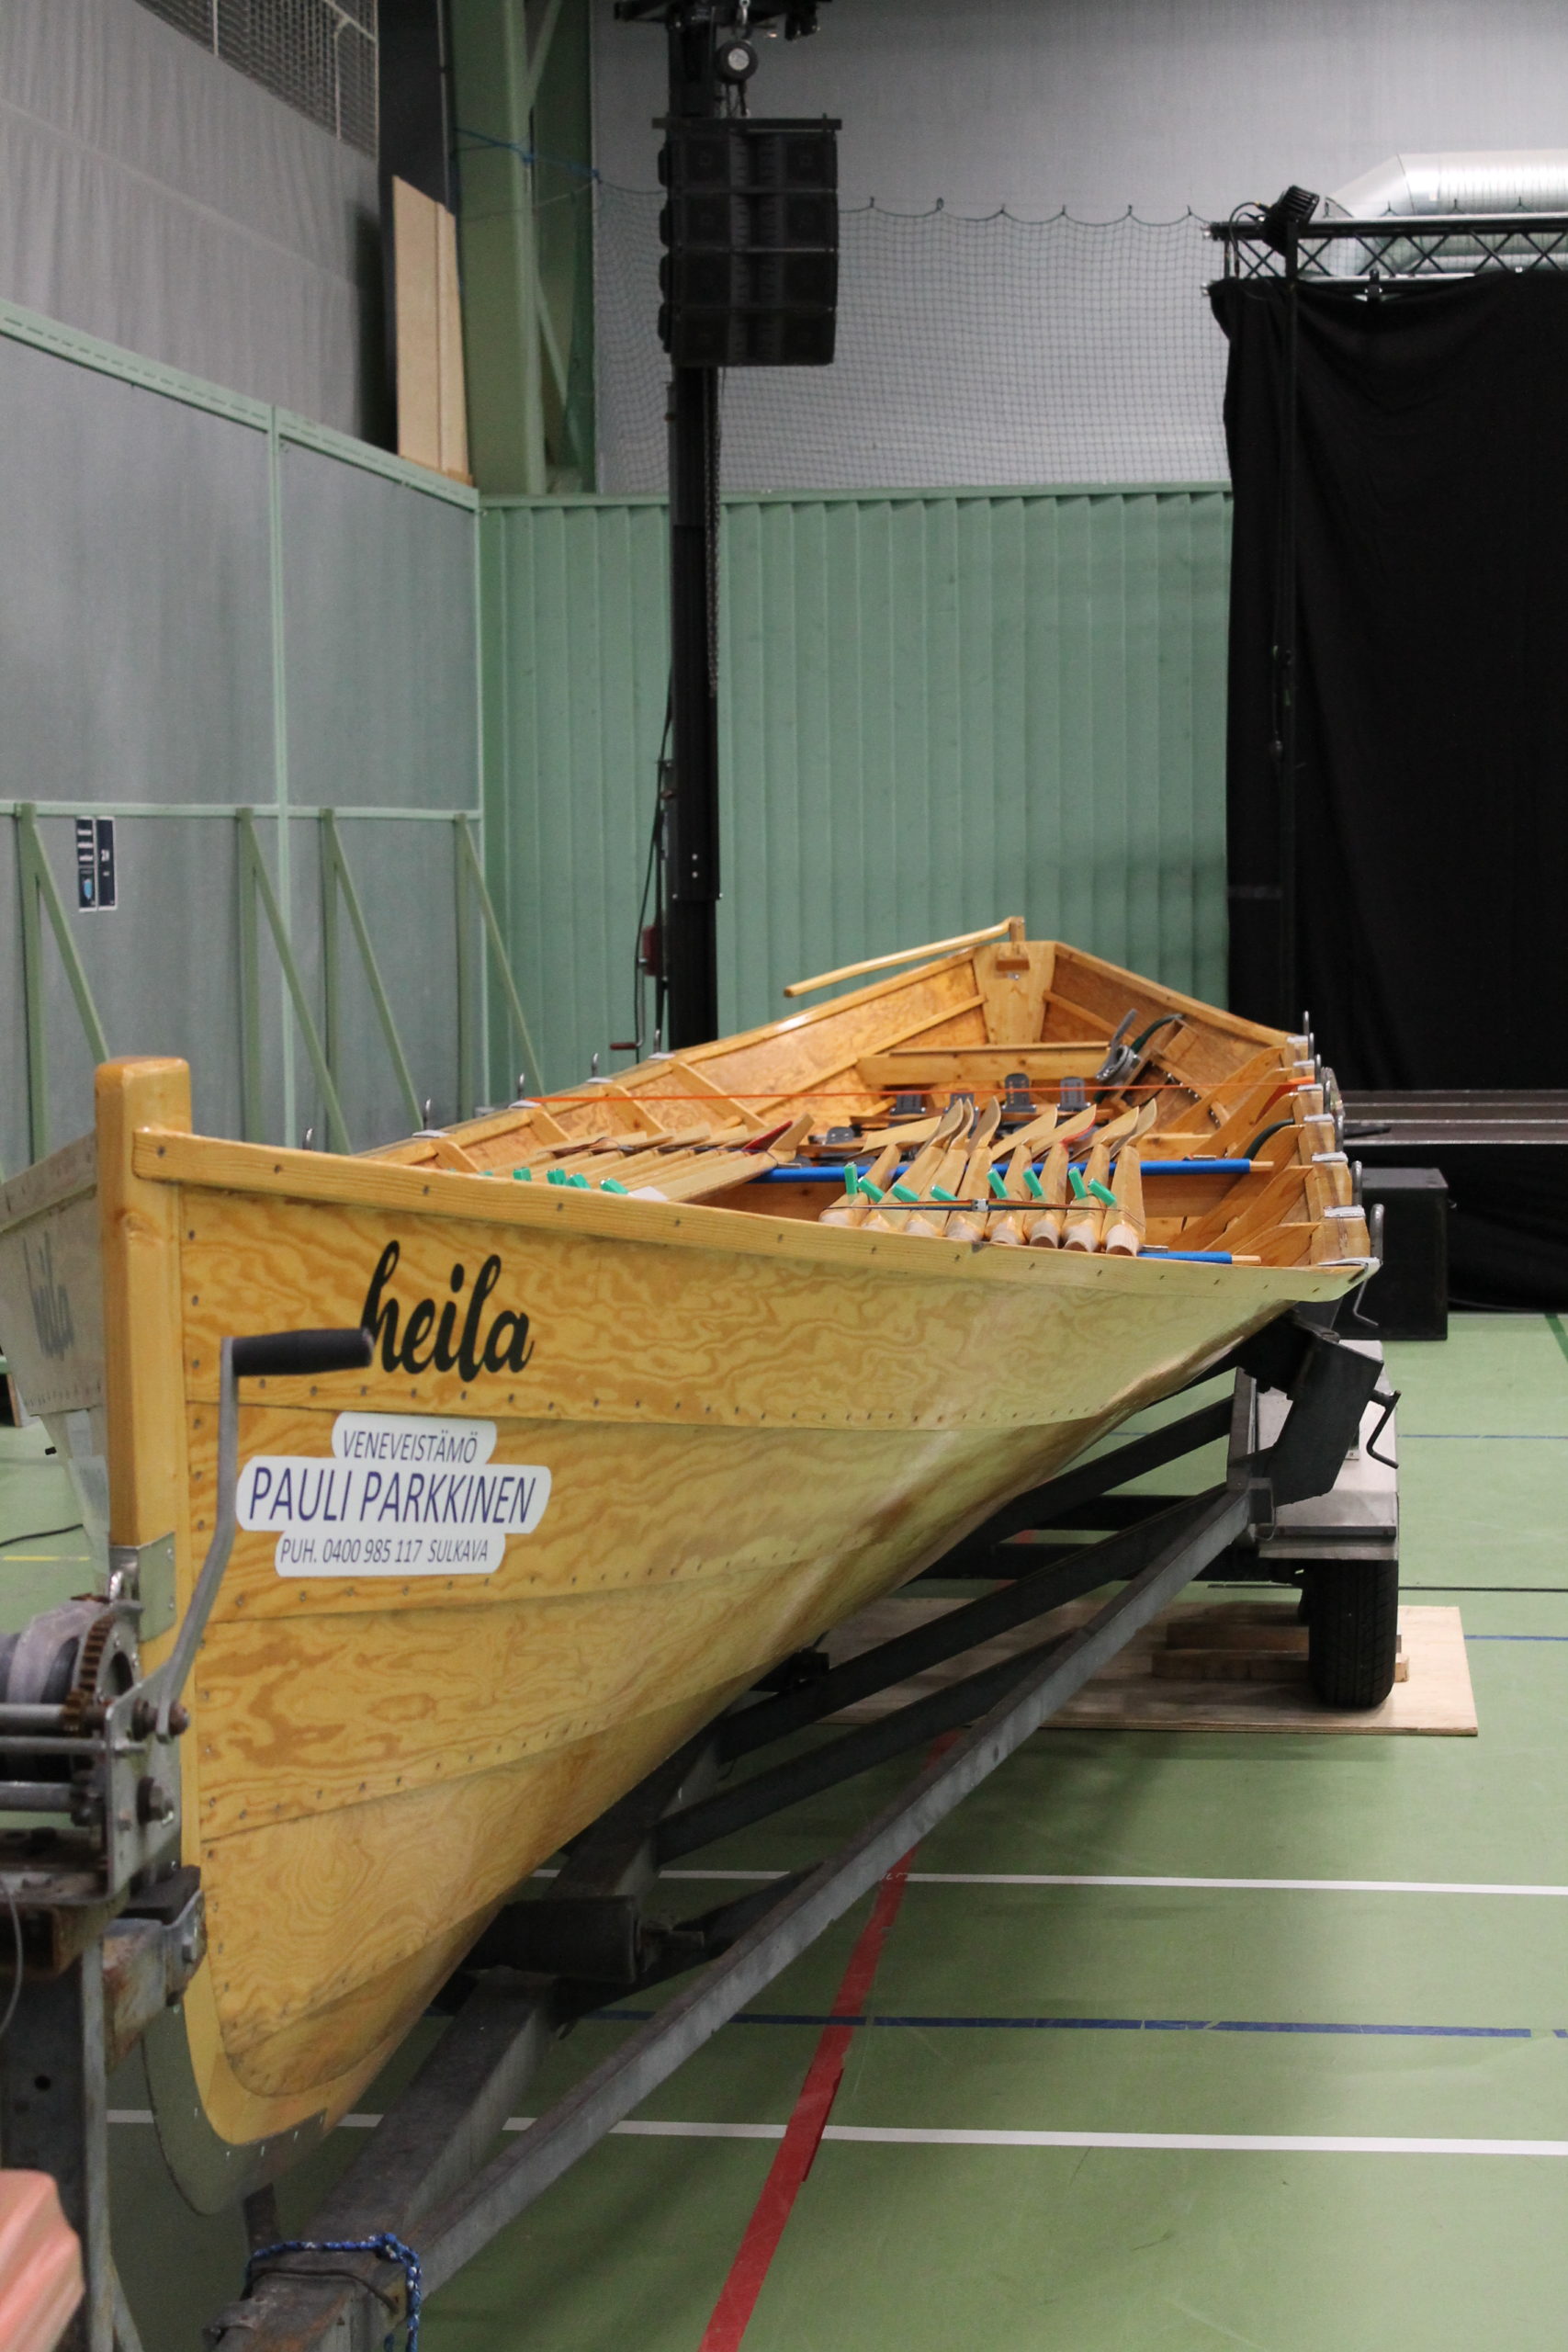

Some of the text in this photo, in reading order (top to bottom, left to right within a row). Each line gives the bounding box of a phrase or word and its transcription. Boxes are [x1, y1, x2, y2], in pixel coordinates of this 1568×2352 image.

[361, 1240, 535, 1382] heila
[344, 1430, 478, 1464] VENEVEISTÄMÖ
[250, 1467, 536, 1523] PAULI PARKKINEN
[280, 1539, 489, 1563] PUH. 0400 985 117 SULKAVA
